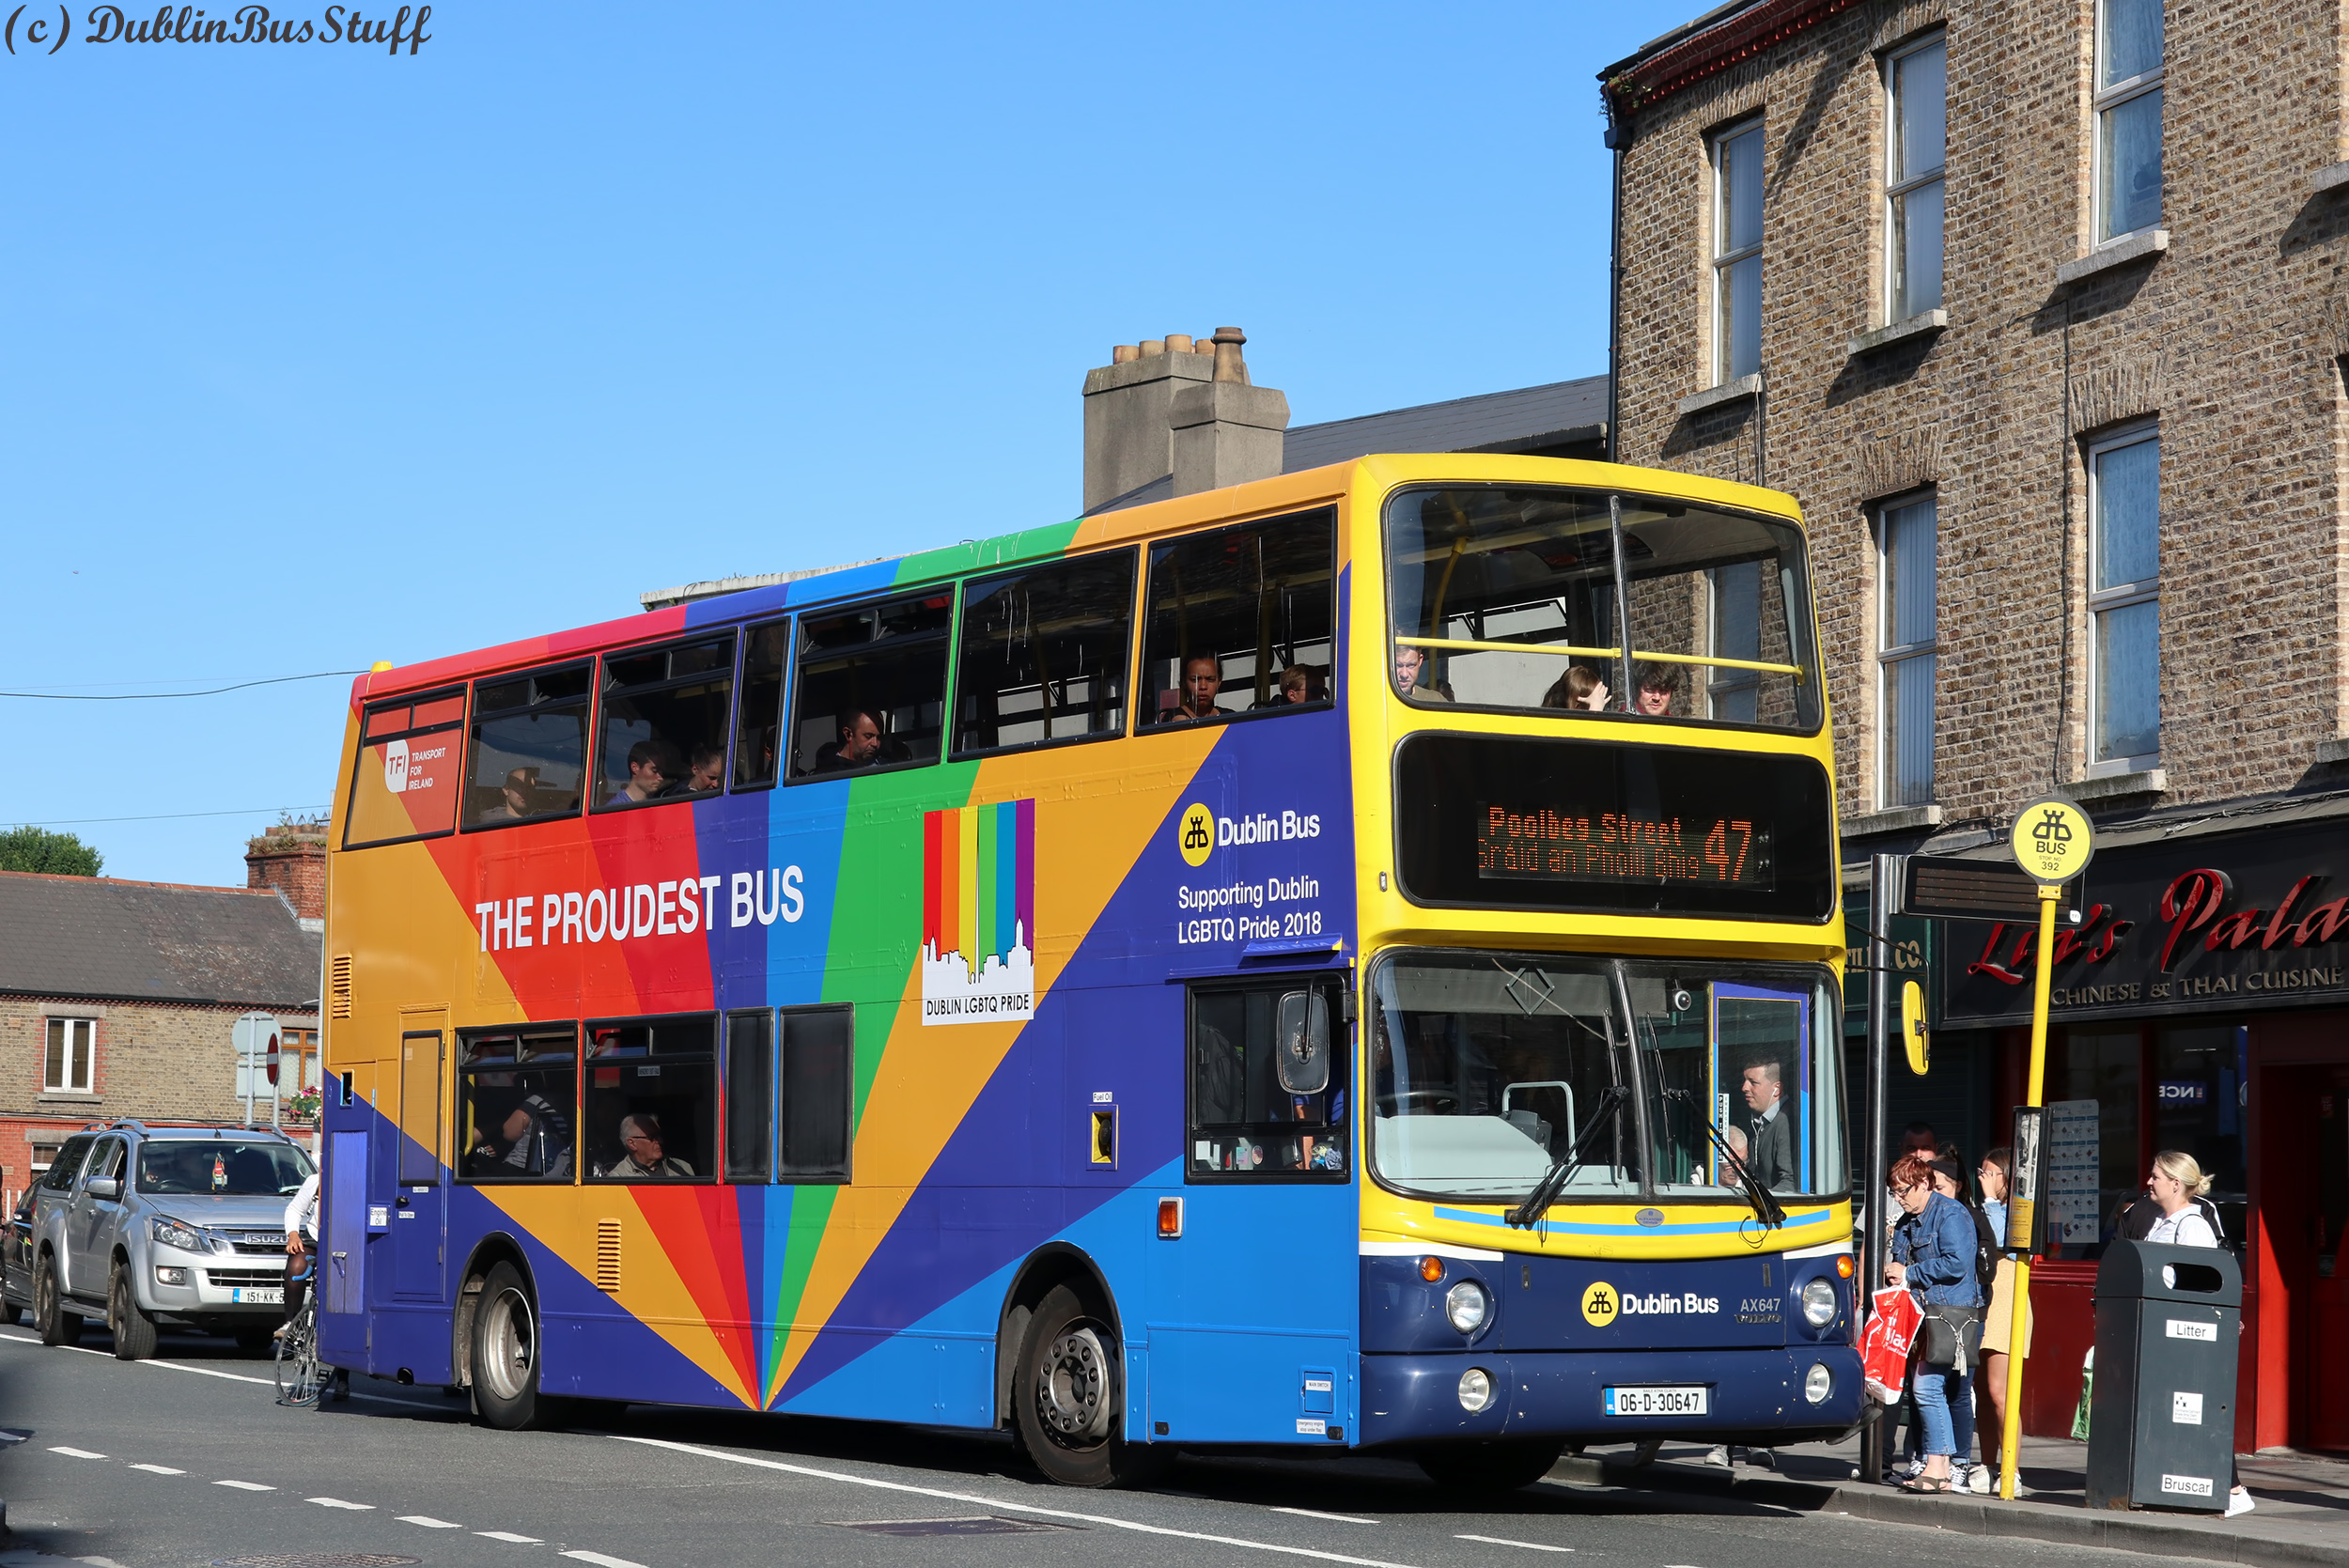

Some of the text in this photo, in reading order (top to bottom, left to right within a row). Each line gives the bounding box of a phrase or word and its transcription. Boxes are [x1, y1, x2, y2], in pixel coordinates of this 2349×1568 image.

[389, 755, 406, 775] TFI
[412, 747, 446, 763] TRANSPORT
[410, 766, 423, 777] FOR
[408, 777, 434, 791] IRELAND
[1218, 810, 1321, 846] Dublin Bus
[1489, 806, 1752, 881] Poolbeg Street 47
[2036, 841, 2066, 855] BUS
[1549, 848, 1578, 874] an
[2041, 862, 2060, 872] 392
[1178, 875, 1319, 913] Supporting Dublin
[475, 865, 804, 953] THE PROUDEST BUS
[1178, 910, 1322, 944] LGBTQ Pride 2018
[2050, 966, 2345, 1006] CHINESE & THAI CUISINE
[926, 994, 1029, 1017] DUBLIN LGBTQ PRIDE
[370, 1208, 386, 1218] Engine
[1622, 1293, 1719, 1314] Dublin Bus
[1740, 1298, 1781, 1312] AX647
[1734, 1313, 1782, 1324] VOLVO
[2176, 1324, 2207, 1337] Litter
[1620, 1392, 1700, 1412] 06-D-30647
[2164, 1477, 2211, 1494] Bruscar
